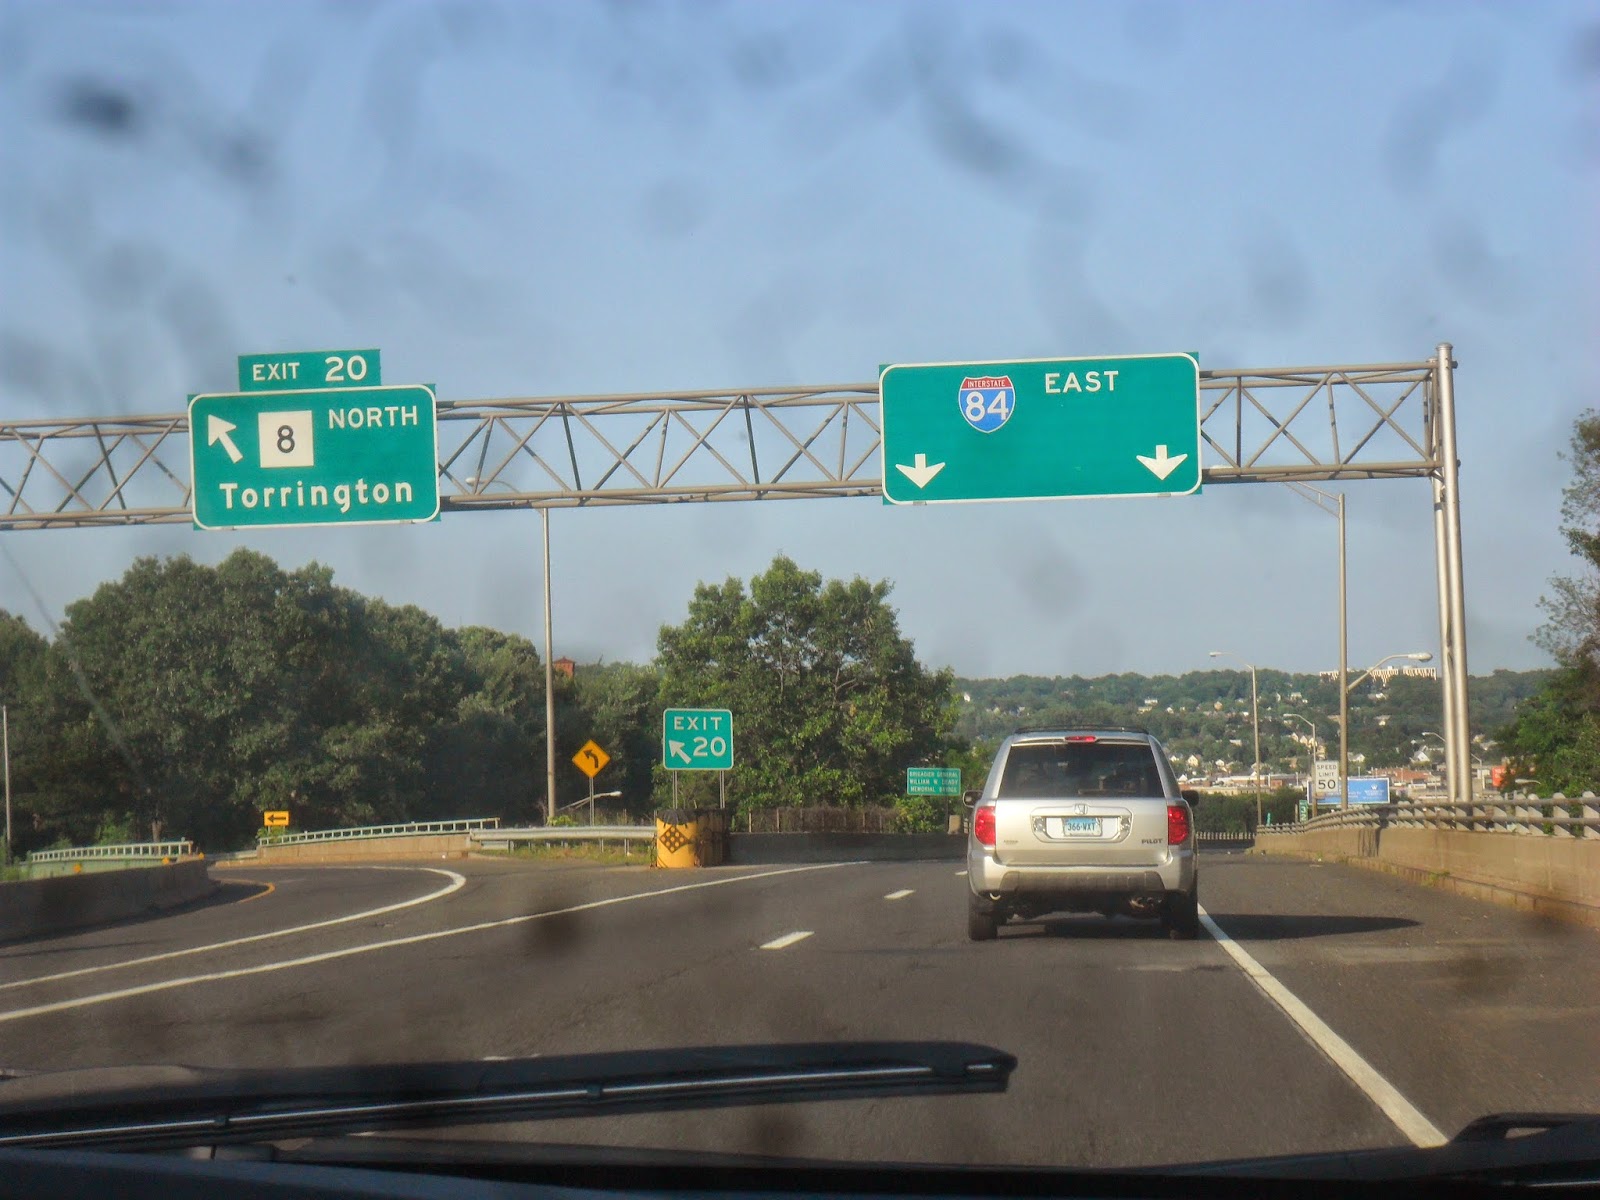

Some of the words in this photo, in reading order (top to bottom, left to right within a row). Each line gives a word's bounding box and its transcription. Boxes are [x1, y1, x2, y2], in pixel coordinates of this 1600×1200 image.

[252, 362, 300, 381] EXIT
[325, 355, 368, 382] 20
[967, 379, 1006, 388] INTERSTATE
[1045, 370, 1119, 394] EAST
[328, 405, 418, 429] NORTH
[965, 390, 1009, 422] 84
[276, 424, 296, 454] 8
[219, 478, 413, 513] Torrington
[674, 716, 722, 731] EXIT
[693, 736, 726, 757] 20
[1318, 779, 1336, 790] 50
